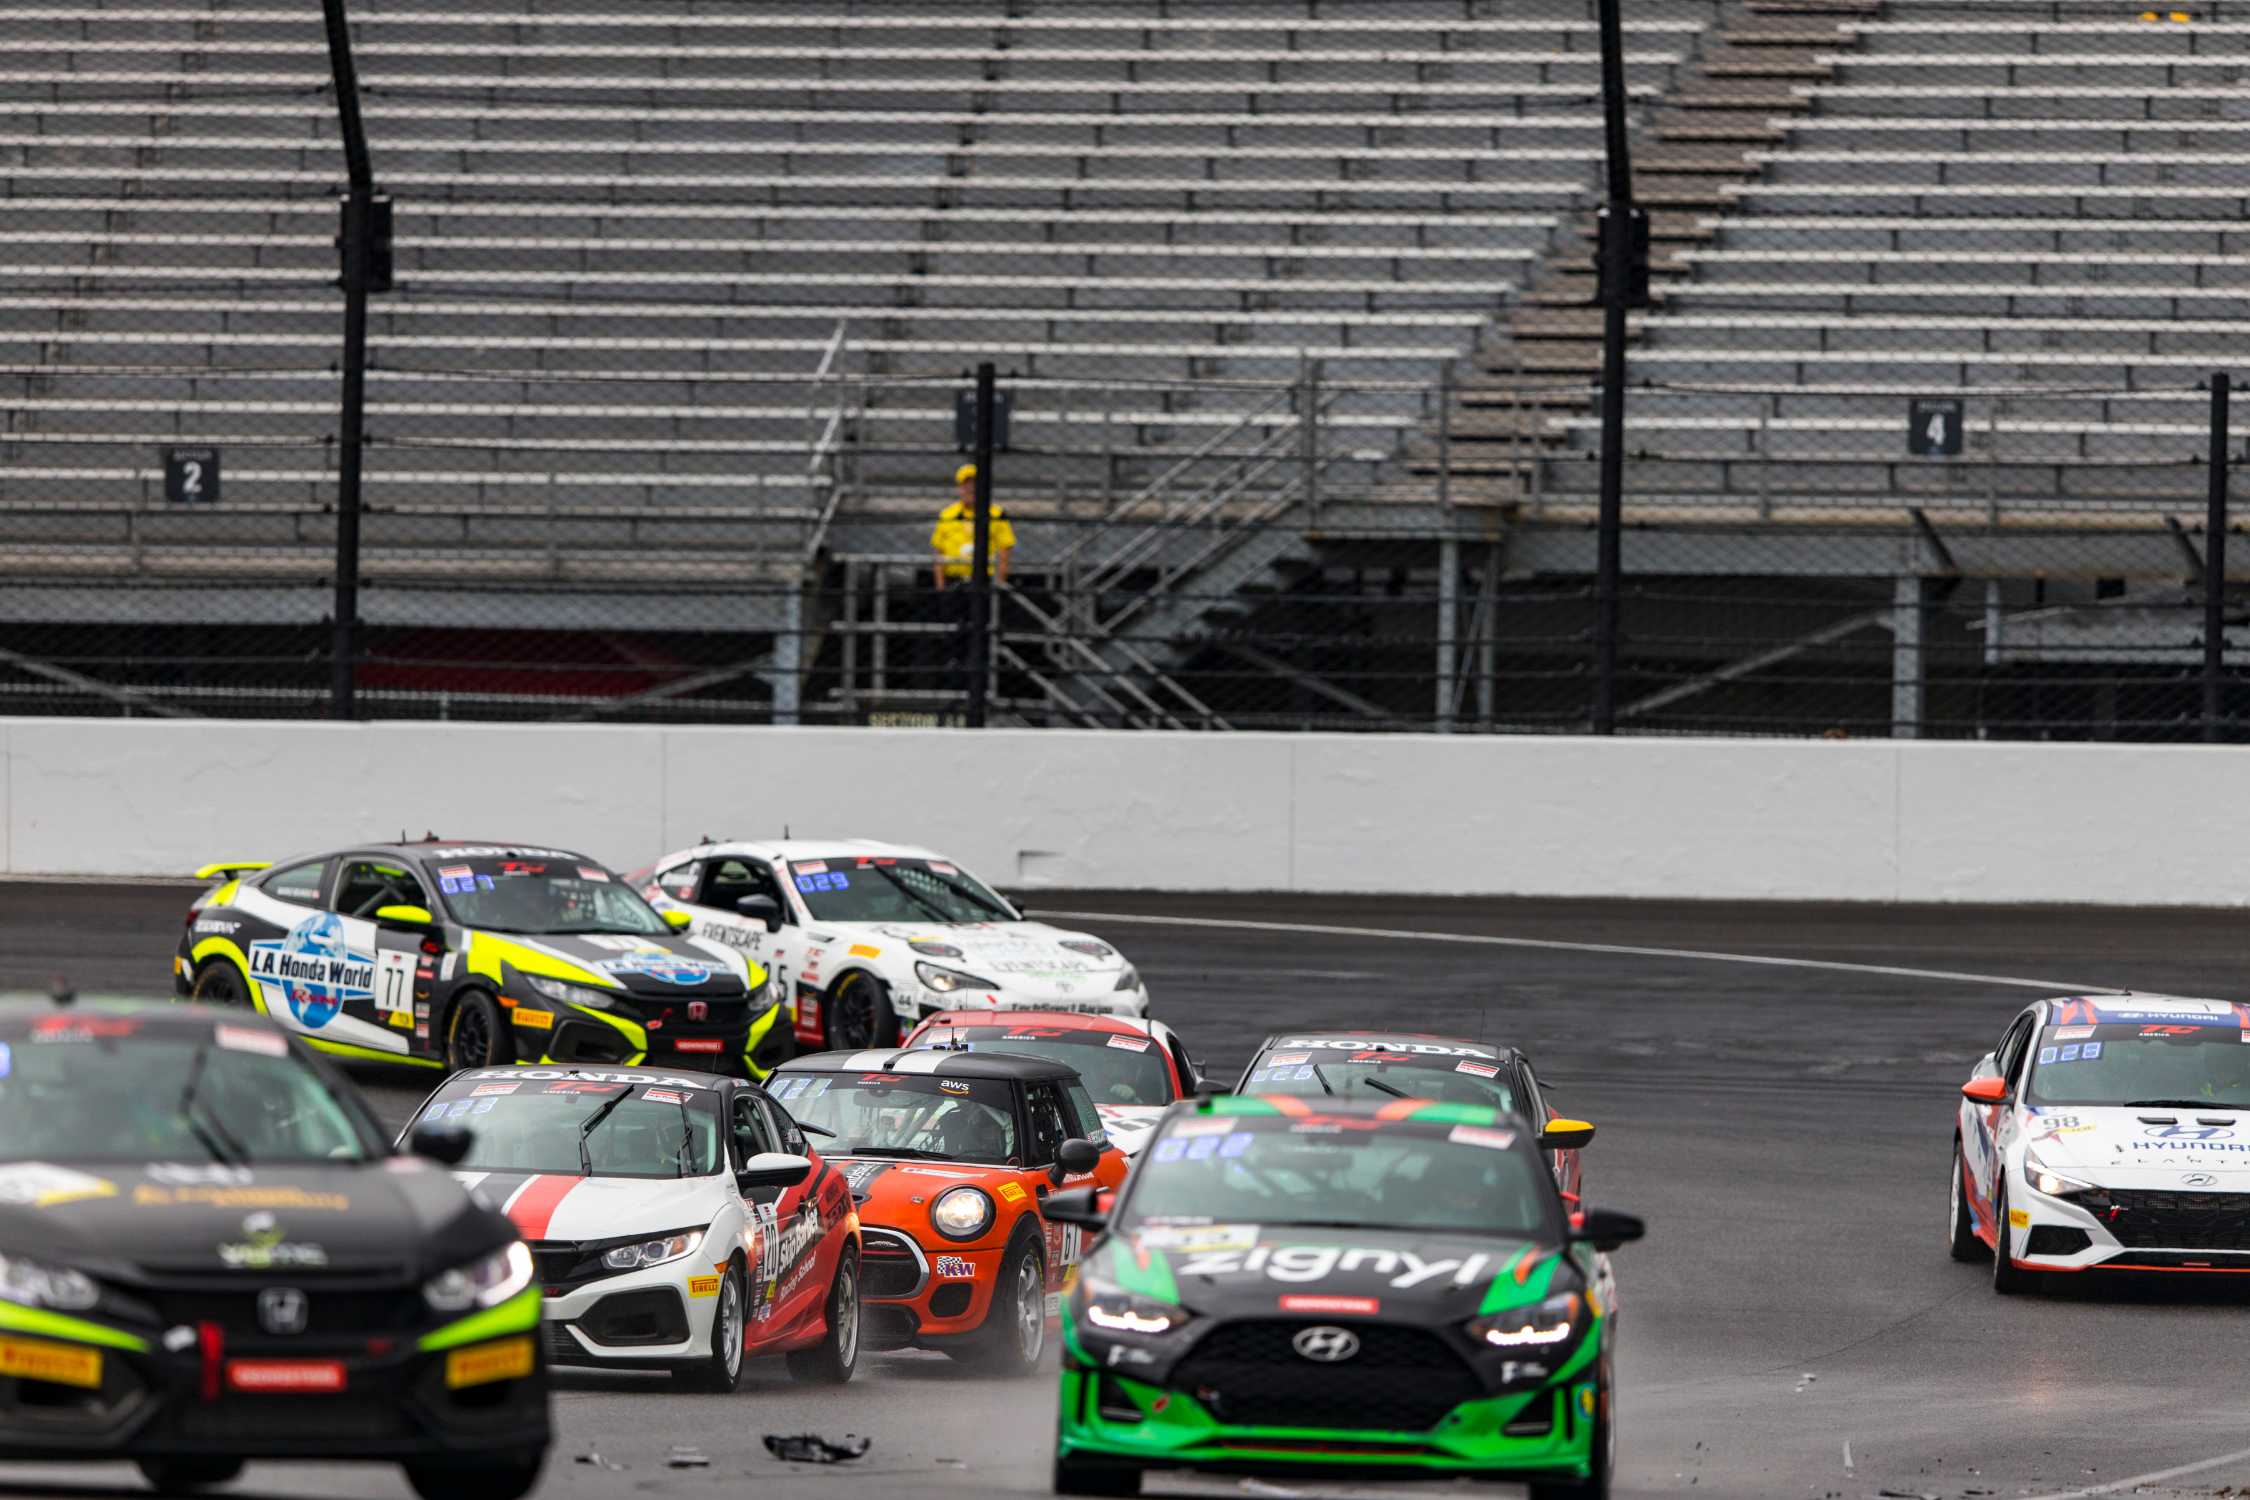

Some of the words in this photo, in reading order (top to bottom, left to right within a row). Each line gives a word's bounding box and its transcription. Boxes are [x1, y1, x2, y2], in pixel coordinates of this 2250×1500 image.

[1926, 413, 1945, 446] 4
[182, 460, 203, 493] 2
[702, 919, 764, 952] EVENTSCAPE
[279, 953, 326, 982] Honda
[329, 961, 373, 989] World
[384, 966, 405, 1008] 77
[2148, 1012, 2220, 1022] HYUNDAI
[1284, 1039, 1496, 1060] HONDA
[472, 1070, 708, 1089] HONDA
[940, 1079, 970, 1091] aws
[2042, 1115, 2081, 1130] 98
[764, 1223, 777, 1277] 20
[944, 1262, 976, 1278] KW
[1179, 1245, 1491, 1289] zignyl
